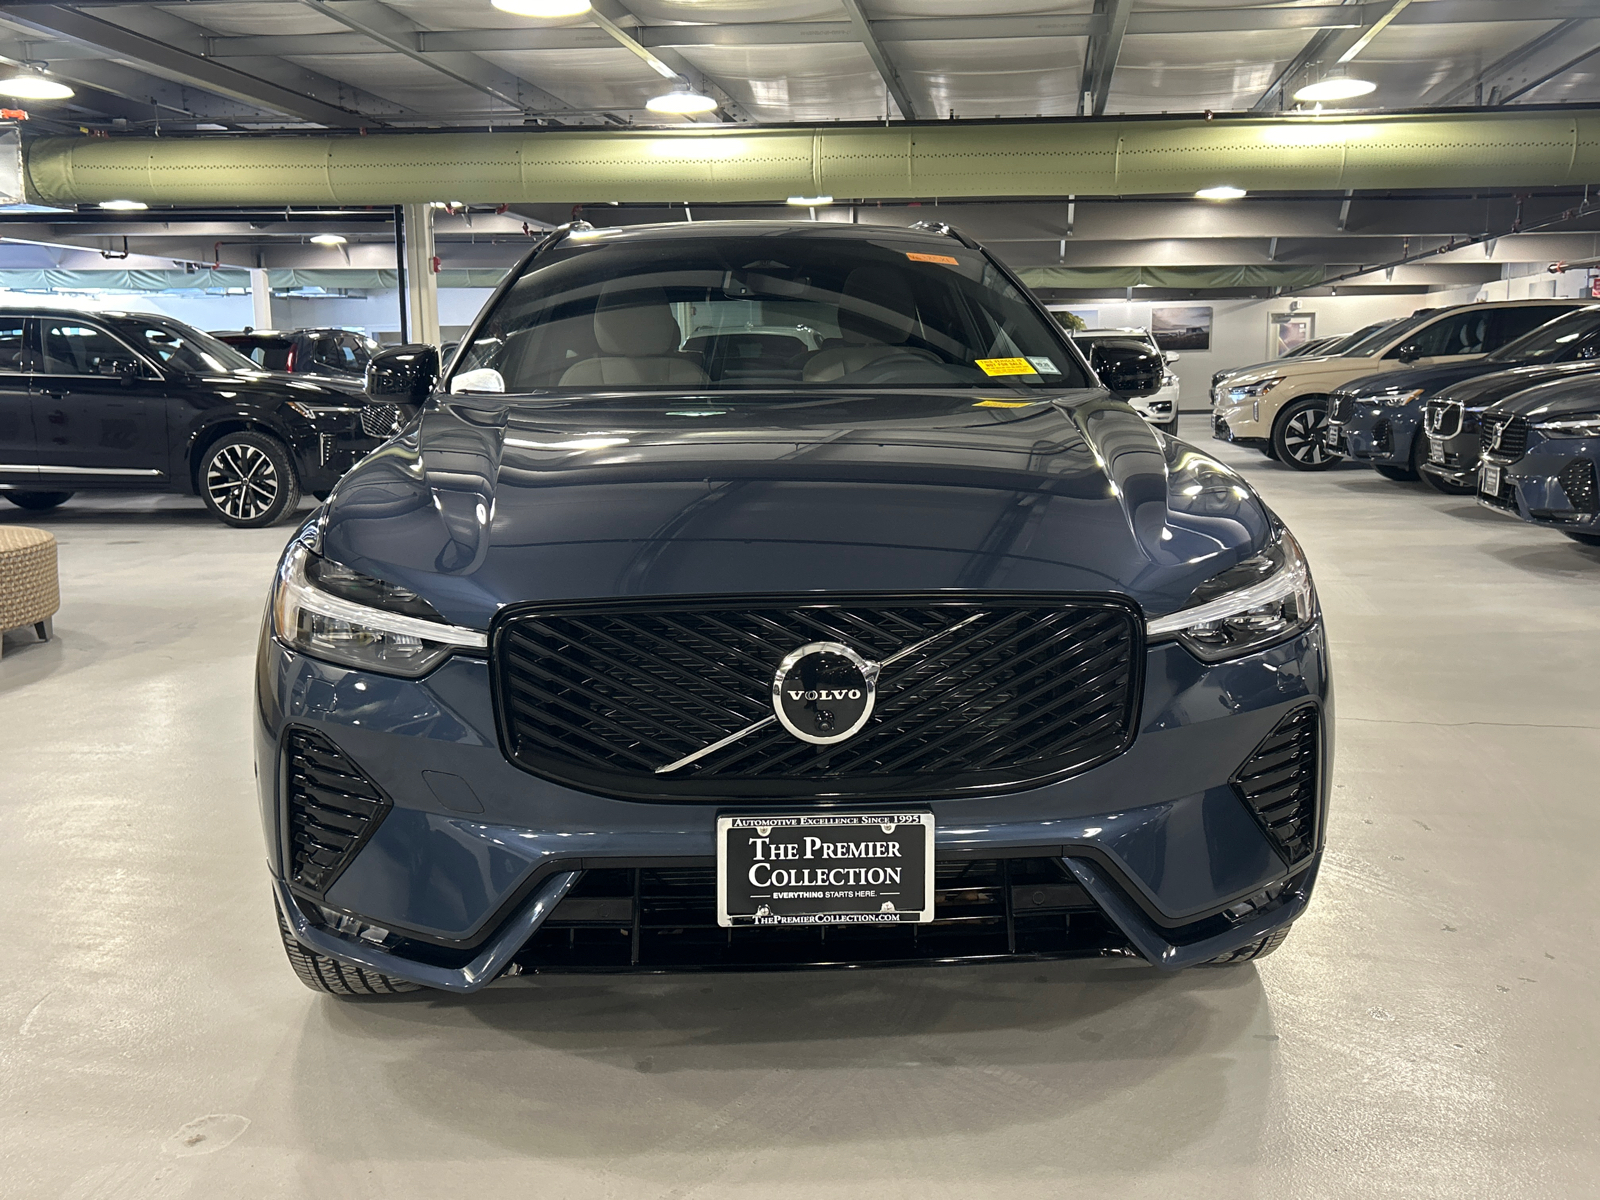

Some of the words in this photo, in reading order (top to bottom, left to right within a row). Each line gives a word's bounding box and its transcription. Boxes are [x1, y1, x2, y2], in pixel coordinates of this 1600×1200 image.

[787, 689, 861, 701] VOLVO
[734, 818, 798, 827] AUTOMOTIVE
[800, 817, 859, 825] EXCELLENCE
[861, 816, 890, 824] SINCE
[893, 815, 919, 823] 1995
[748, 837, 799, 861] THE
[803, 836, 902, 859] PREMIER
[748, 862, 902, 887] COLLECTION
[772, 891, 824, 899] EVERYTHING
[825, 890, 854, 898] STARTS
[752, 914, 900, 925] THEPREMIERCOLLECTION.COM
